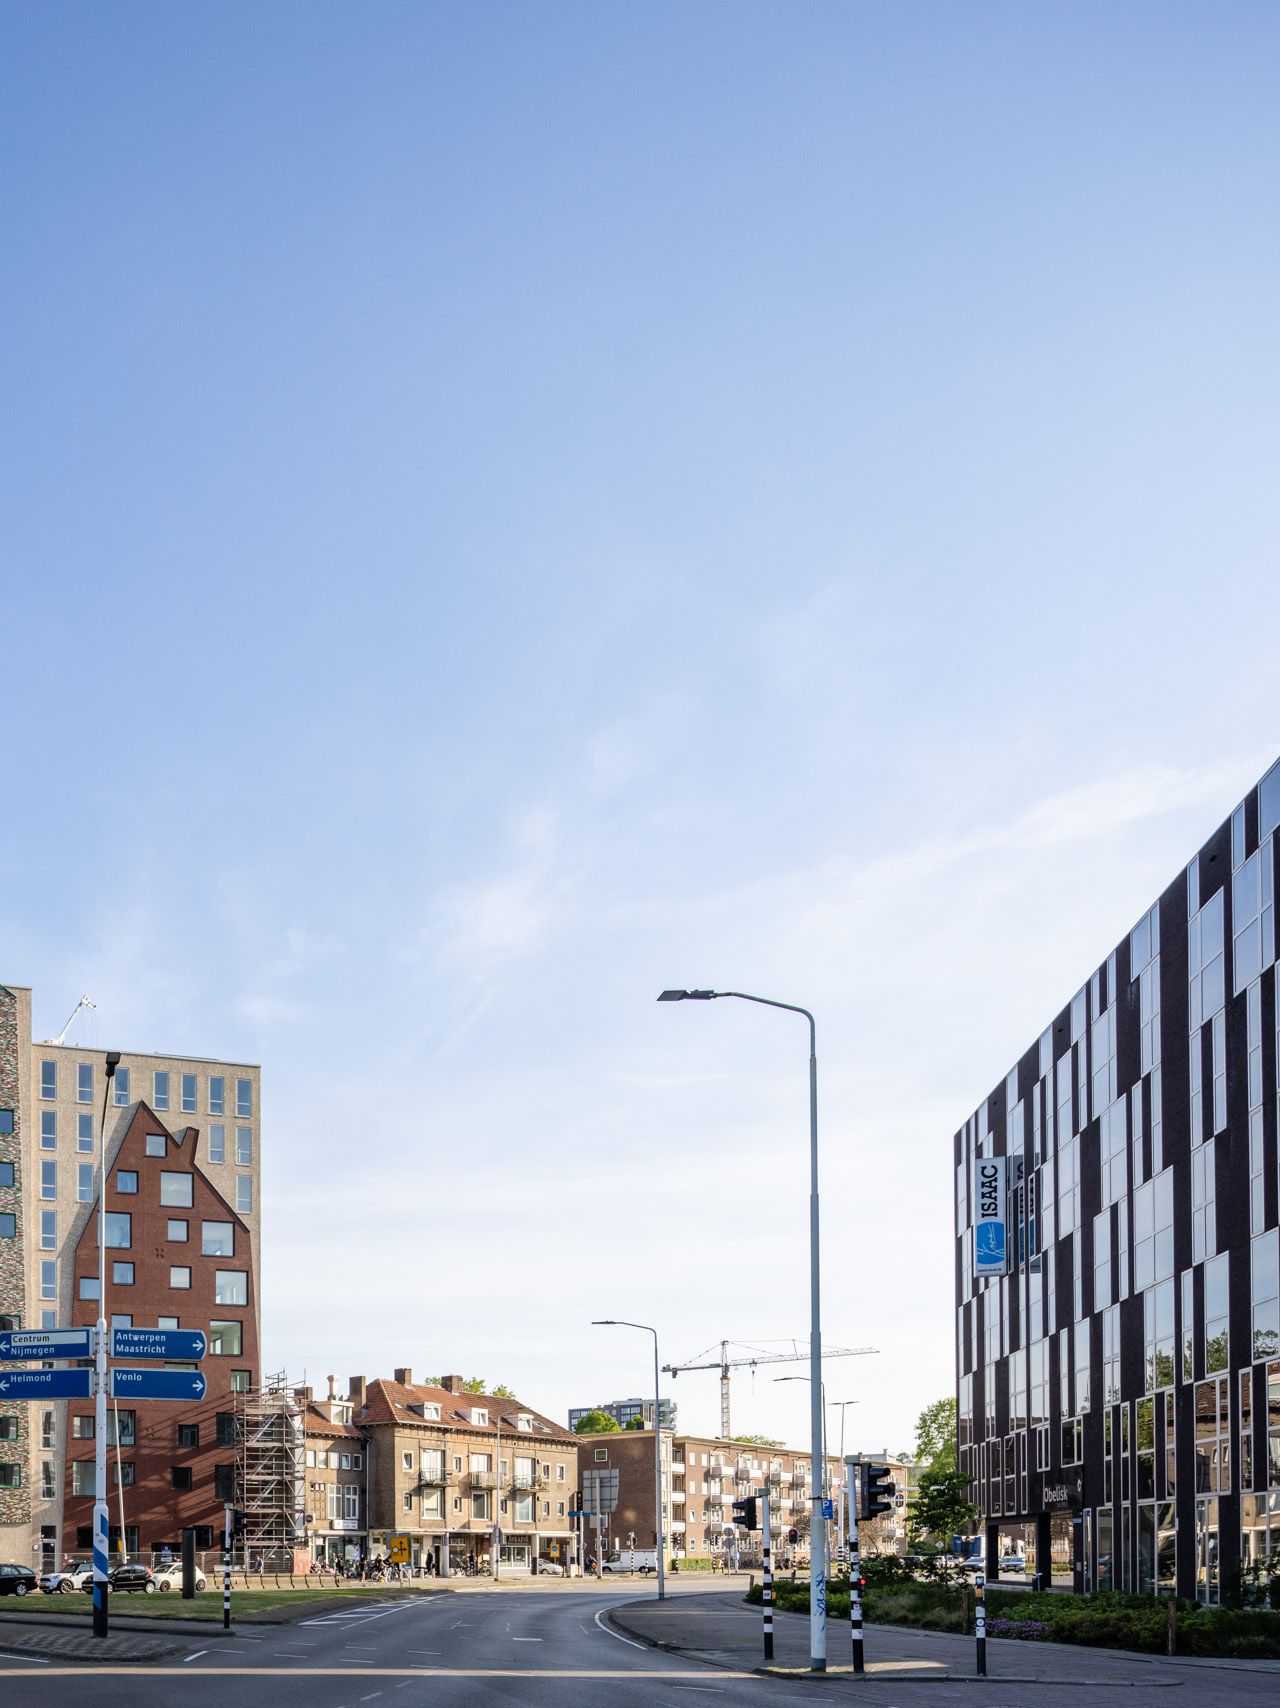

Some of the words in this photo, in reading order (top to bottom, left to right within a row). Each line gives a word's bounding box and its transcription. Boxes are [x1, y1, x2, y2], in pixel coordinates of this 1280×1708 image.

[980, 1164, 998, 1218] ISAAC
[12, 1334, 50, 1343] Centrum
[116, 1332, 166, 1345] Antwerpen
[10, 1346, 55, 1357] Nijmegen
[116, 1345, 166, 1354] Maastricht
[10, 1374, 51, 1383] Helmond
[116, 1373, 142, 1381] Venlo
[1044, 1485, 1068, 1502] Obelisk
